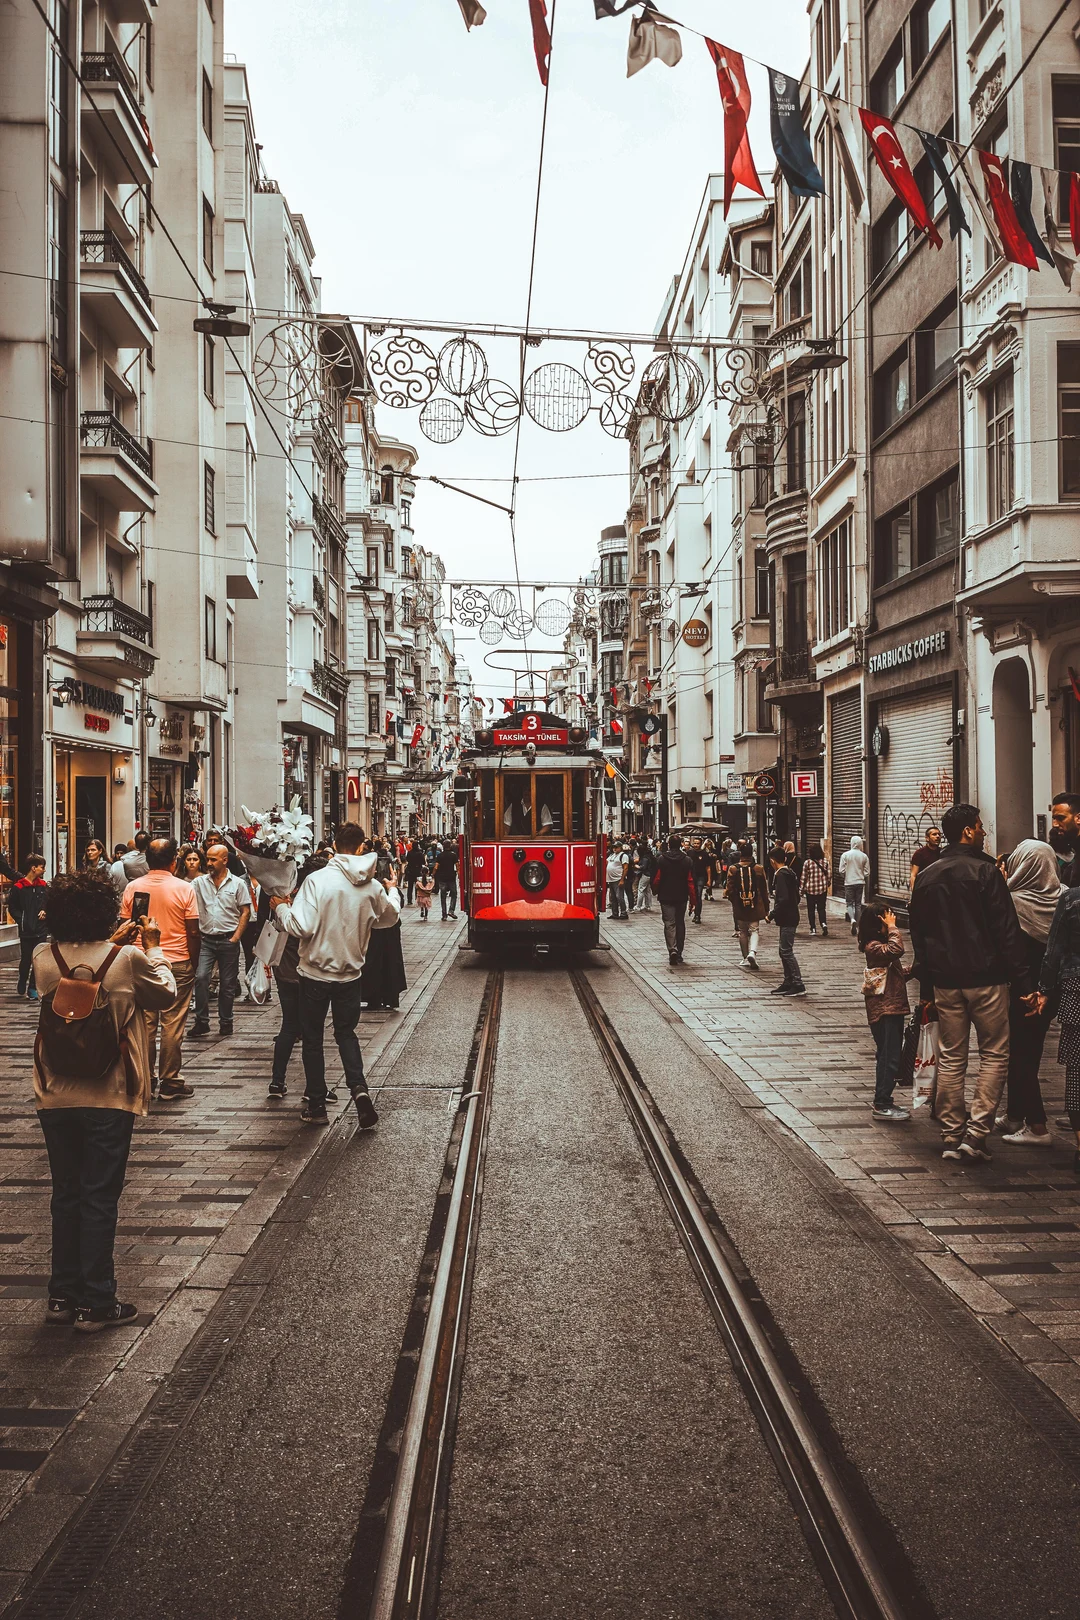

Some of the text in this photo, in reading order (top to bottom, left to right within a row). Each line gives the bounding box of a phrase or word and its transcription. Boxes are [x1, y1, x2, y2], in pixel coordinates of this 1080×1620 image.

[869, 631, 946, 674] STARBUCKS COFFEE
[526, 715, 538, 730] 3
[498, 733, 527, 741] TAKSİM
[536, 733, 562, 741] TÜNEL
[797, 776, 811, 792] E
[474, 856, 484, 868] 410
[585, 855, 594, 867] 410
